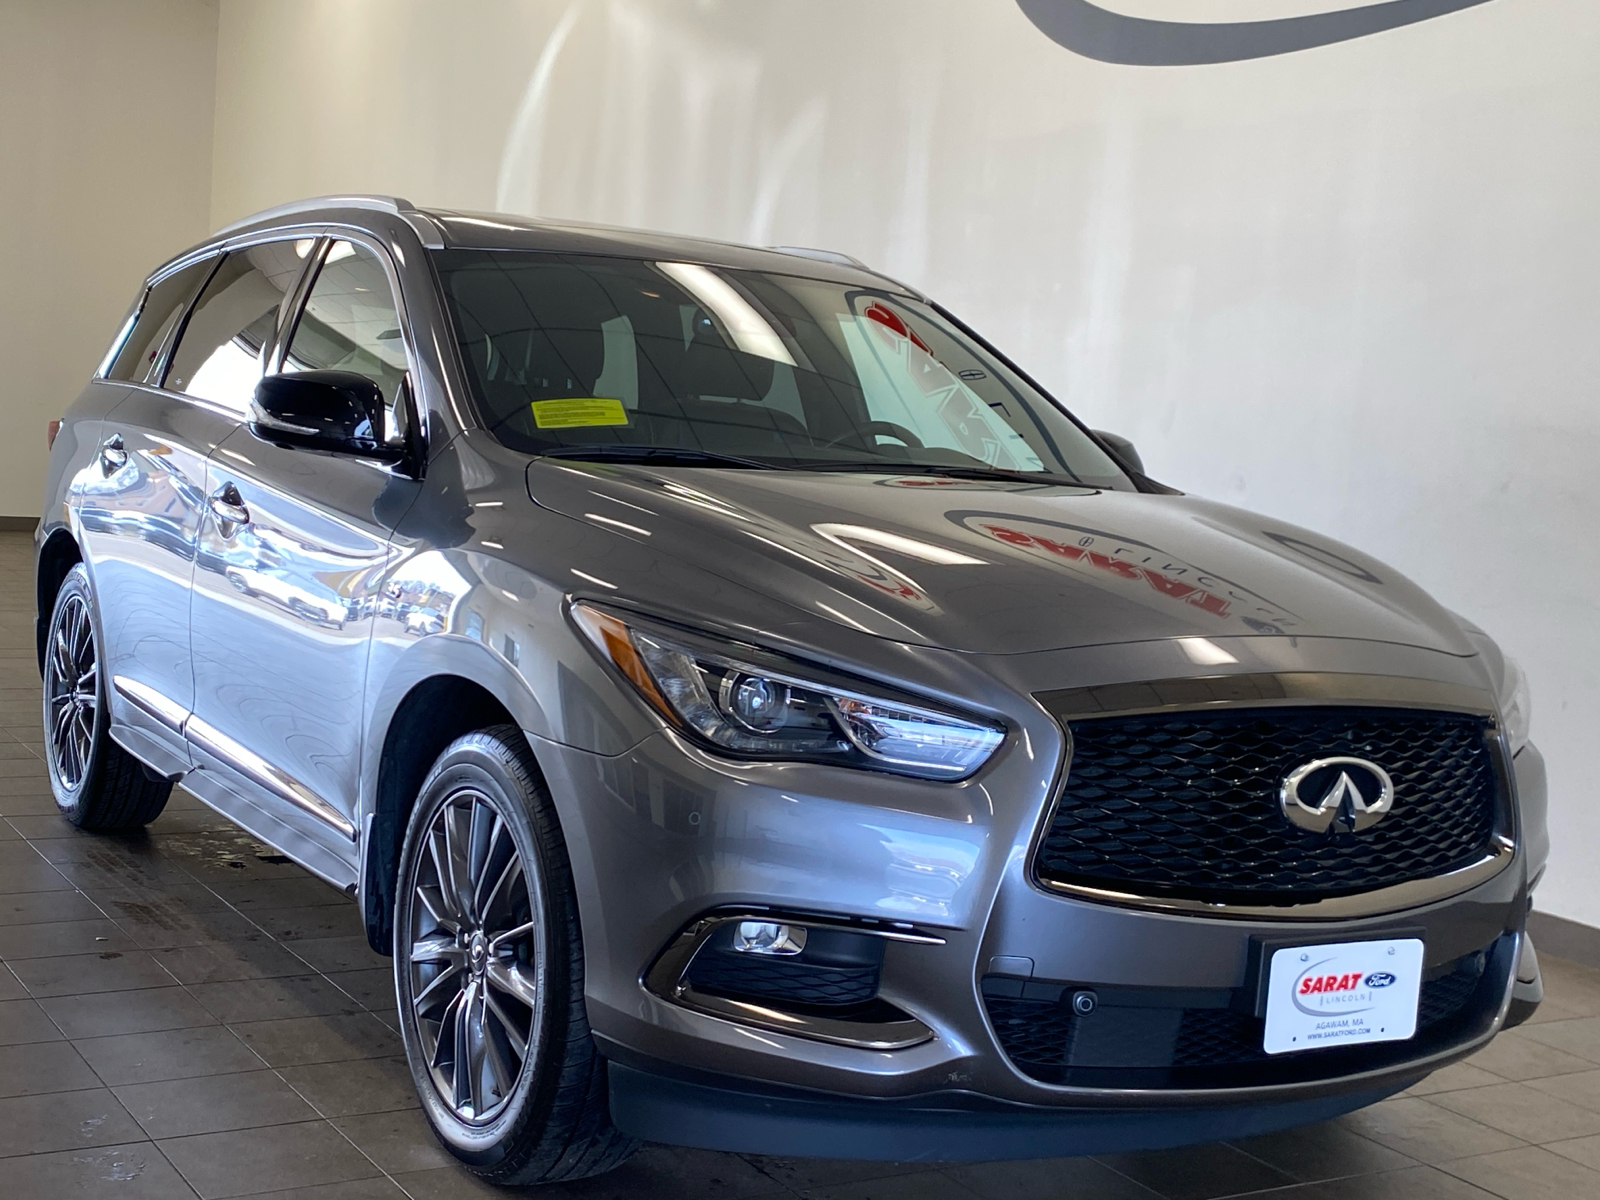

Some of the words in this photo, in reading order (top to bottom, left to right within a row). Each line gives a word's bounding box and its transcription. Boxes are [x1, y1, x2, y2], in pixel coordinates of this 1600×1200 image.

[1299, 973, 1363, 994] SARAT
[1367, 973, 1393, 987] Ford
[1325, 993, 1366, 1004] LINCOLN
[1315, 1020, 1350, 1030] AGAWAM,
[1352, 1018, 1364, 1026] MA
[1307, 1028, 1371, 1040] WWW.SARATFORD.COM
